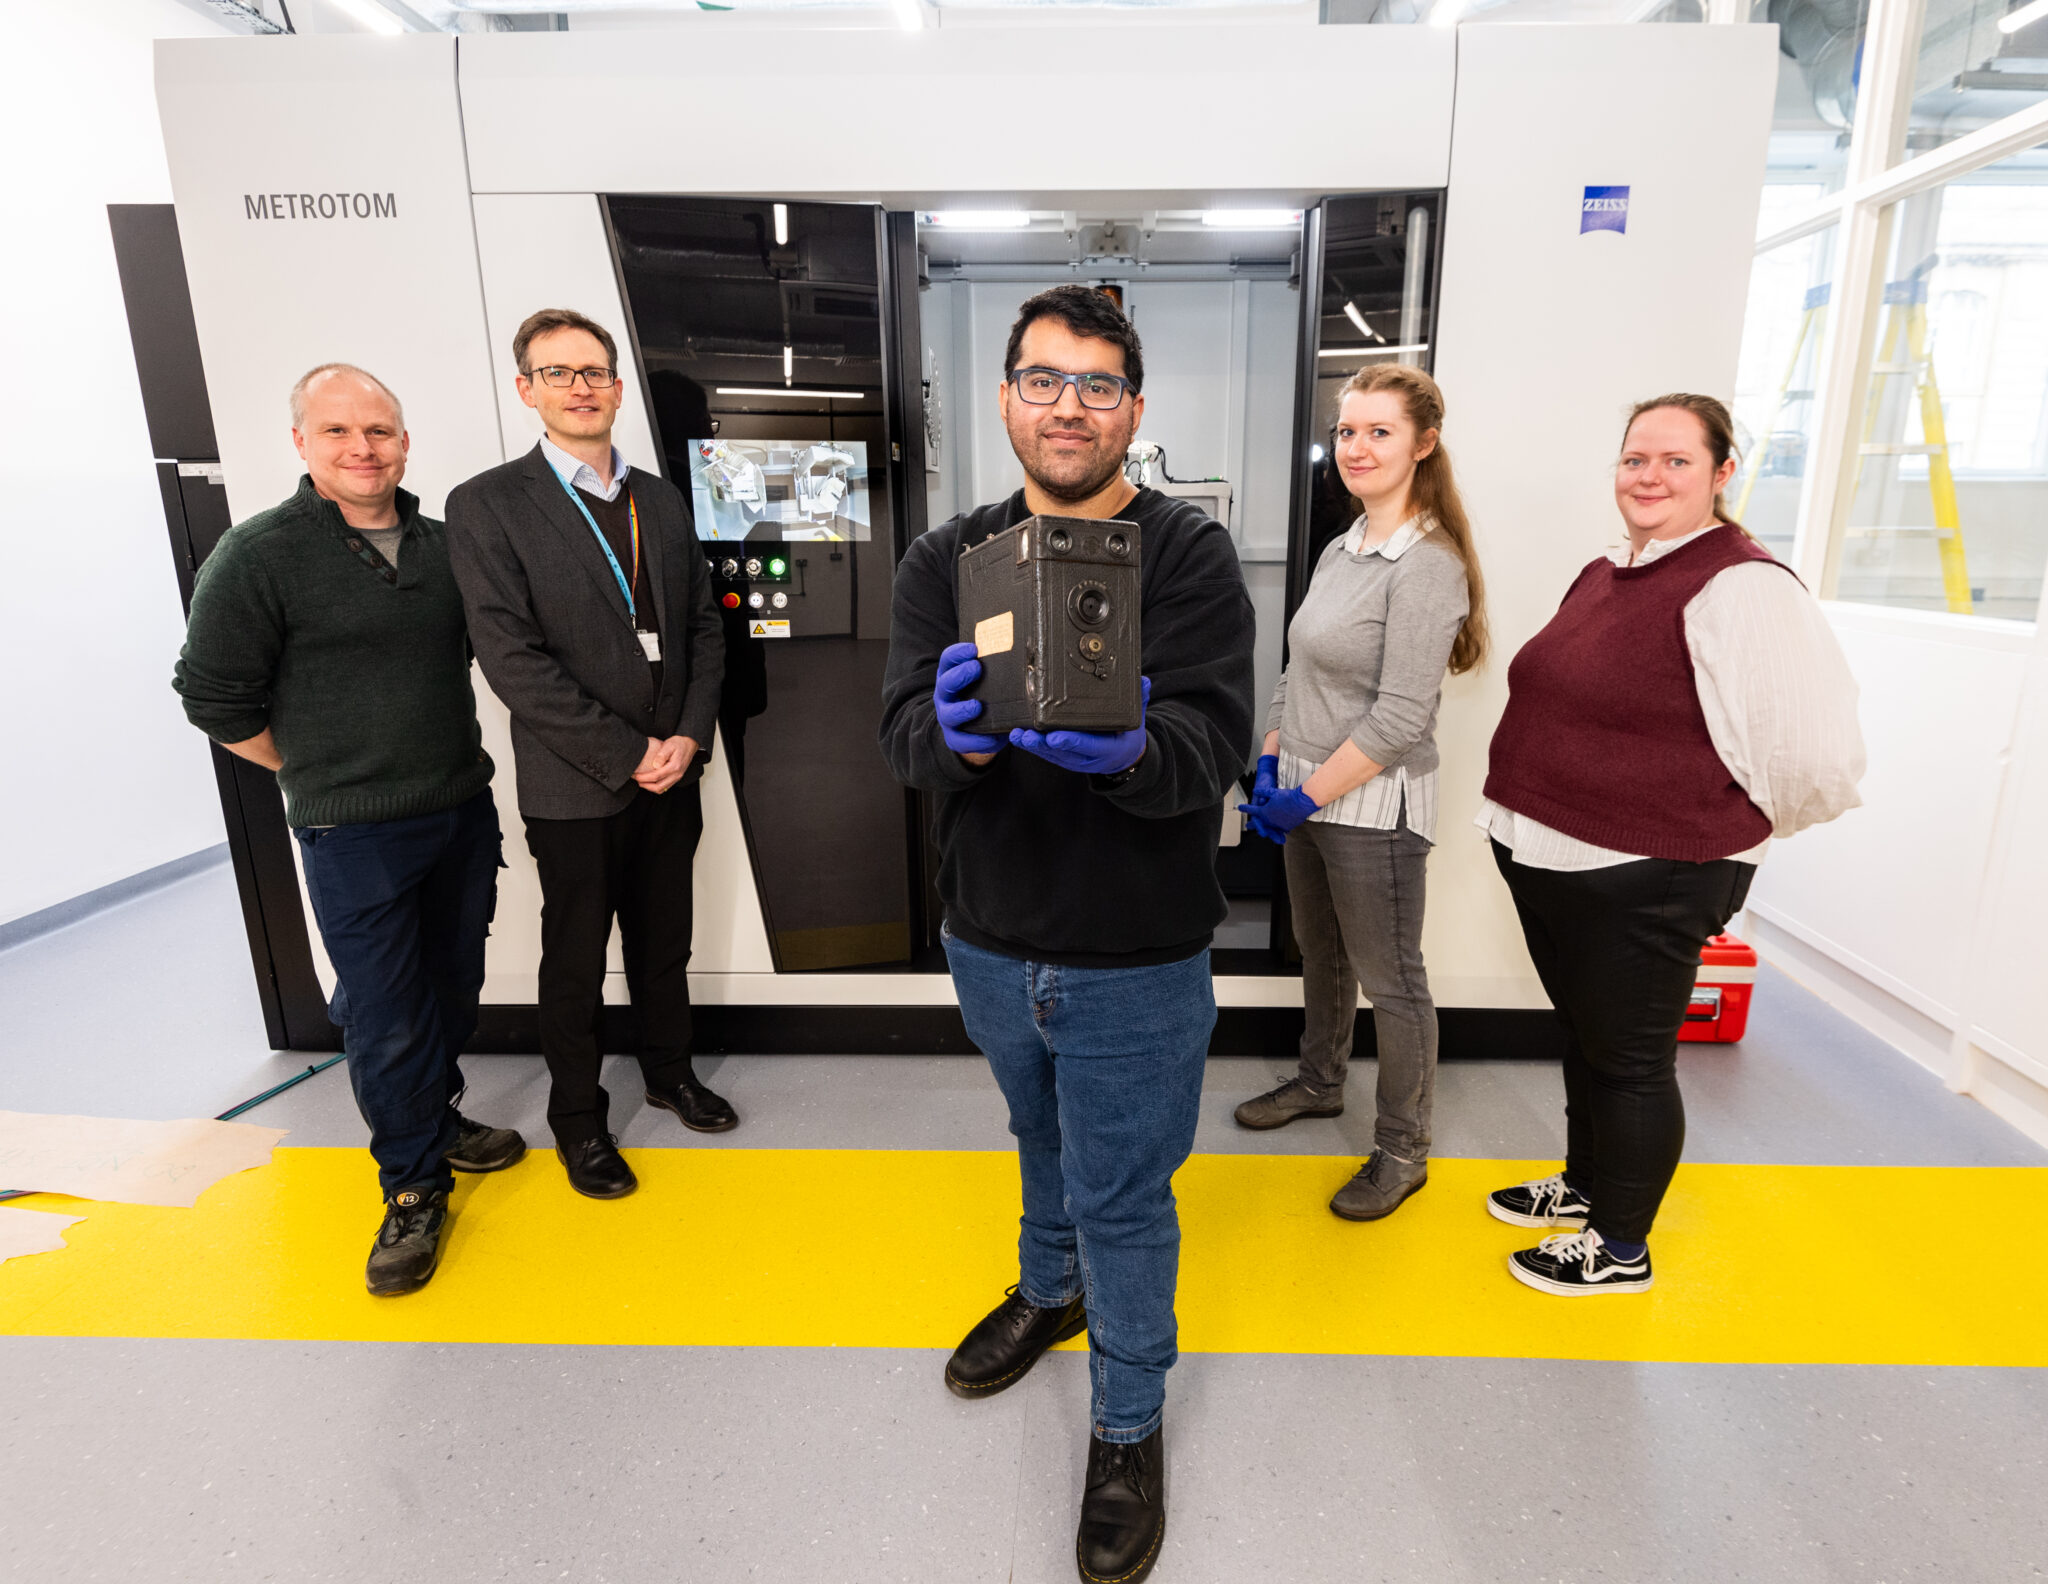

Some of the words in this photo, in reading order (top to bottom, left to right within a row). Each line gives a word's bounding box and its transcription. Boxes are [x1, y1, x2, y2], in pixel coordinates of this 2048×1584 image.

[244, 193, 397, 219] METROTOM
[1583, 198, 1628, 212] ZEISS
[399, 1195, 415, 1204] V12
